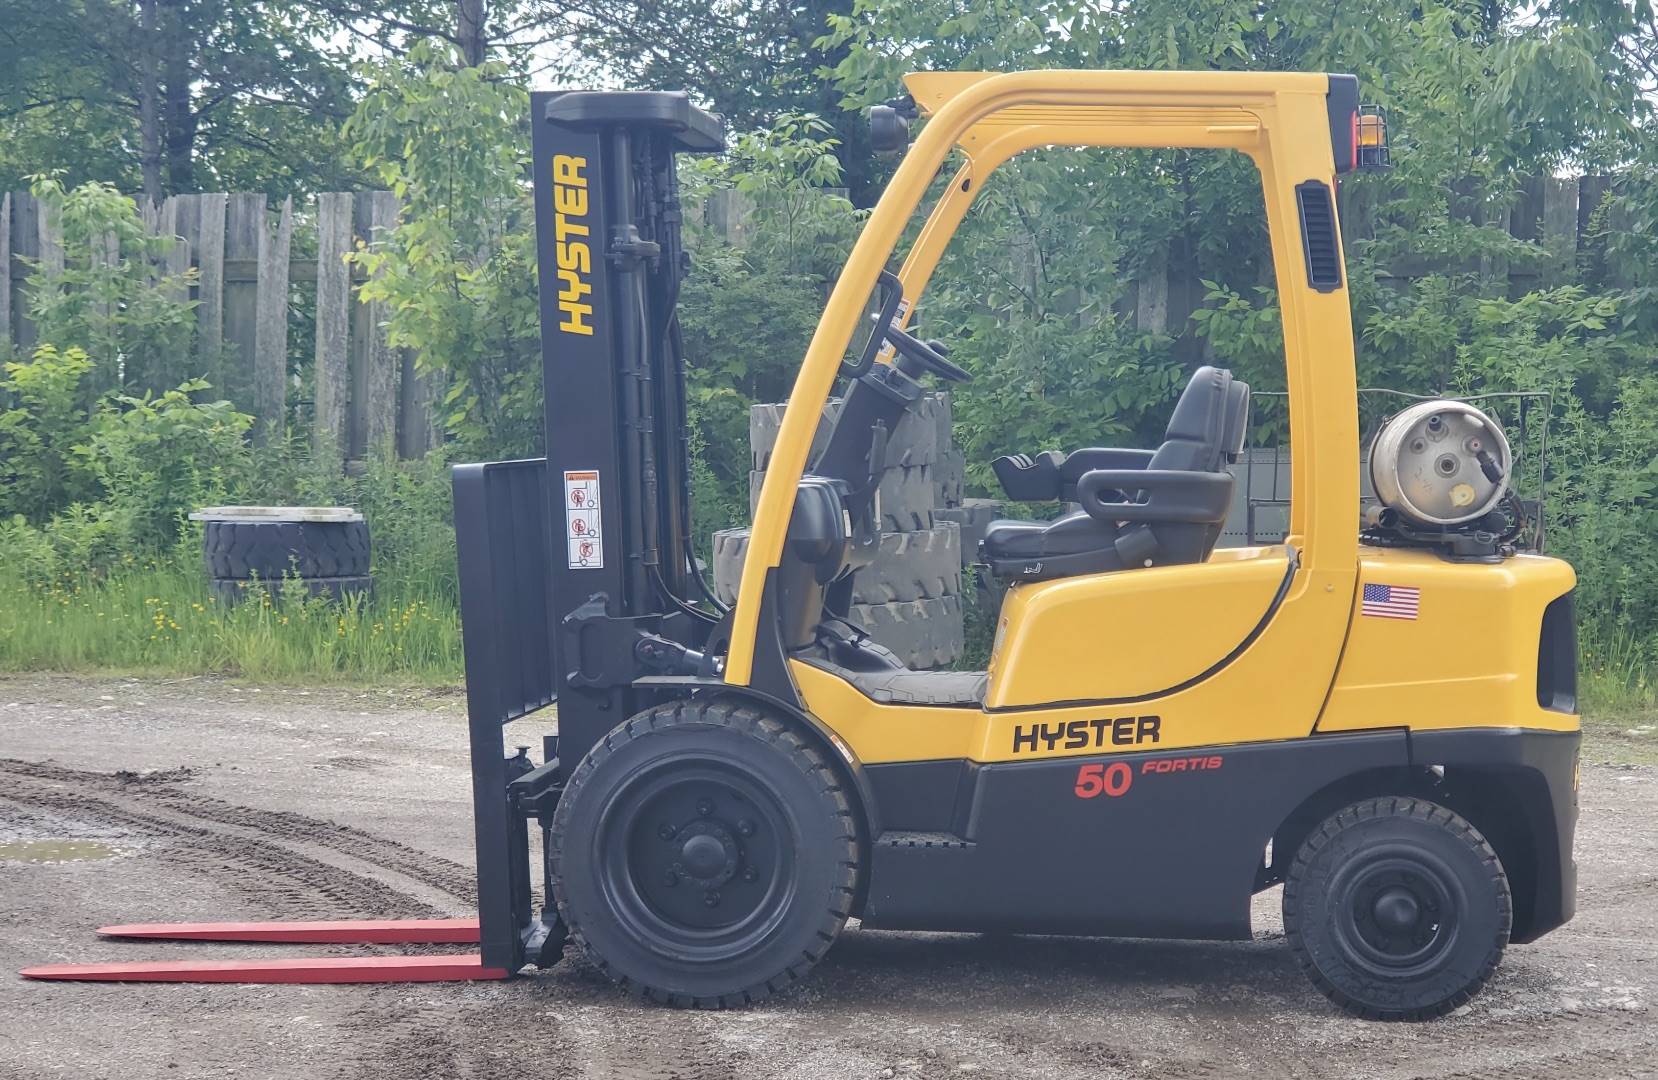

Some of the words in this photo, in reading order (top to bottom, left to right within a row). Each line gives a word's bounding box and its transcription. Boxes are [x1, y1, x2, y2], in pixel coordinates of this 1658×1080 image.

[553, 154, 593, 336] HYSTER
[1013, 715, 1161, 753] HYSTER
[1074, 761, 1132, 799] 50
[1141, 756, 1223, 775] FORTIS
